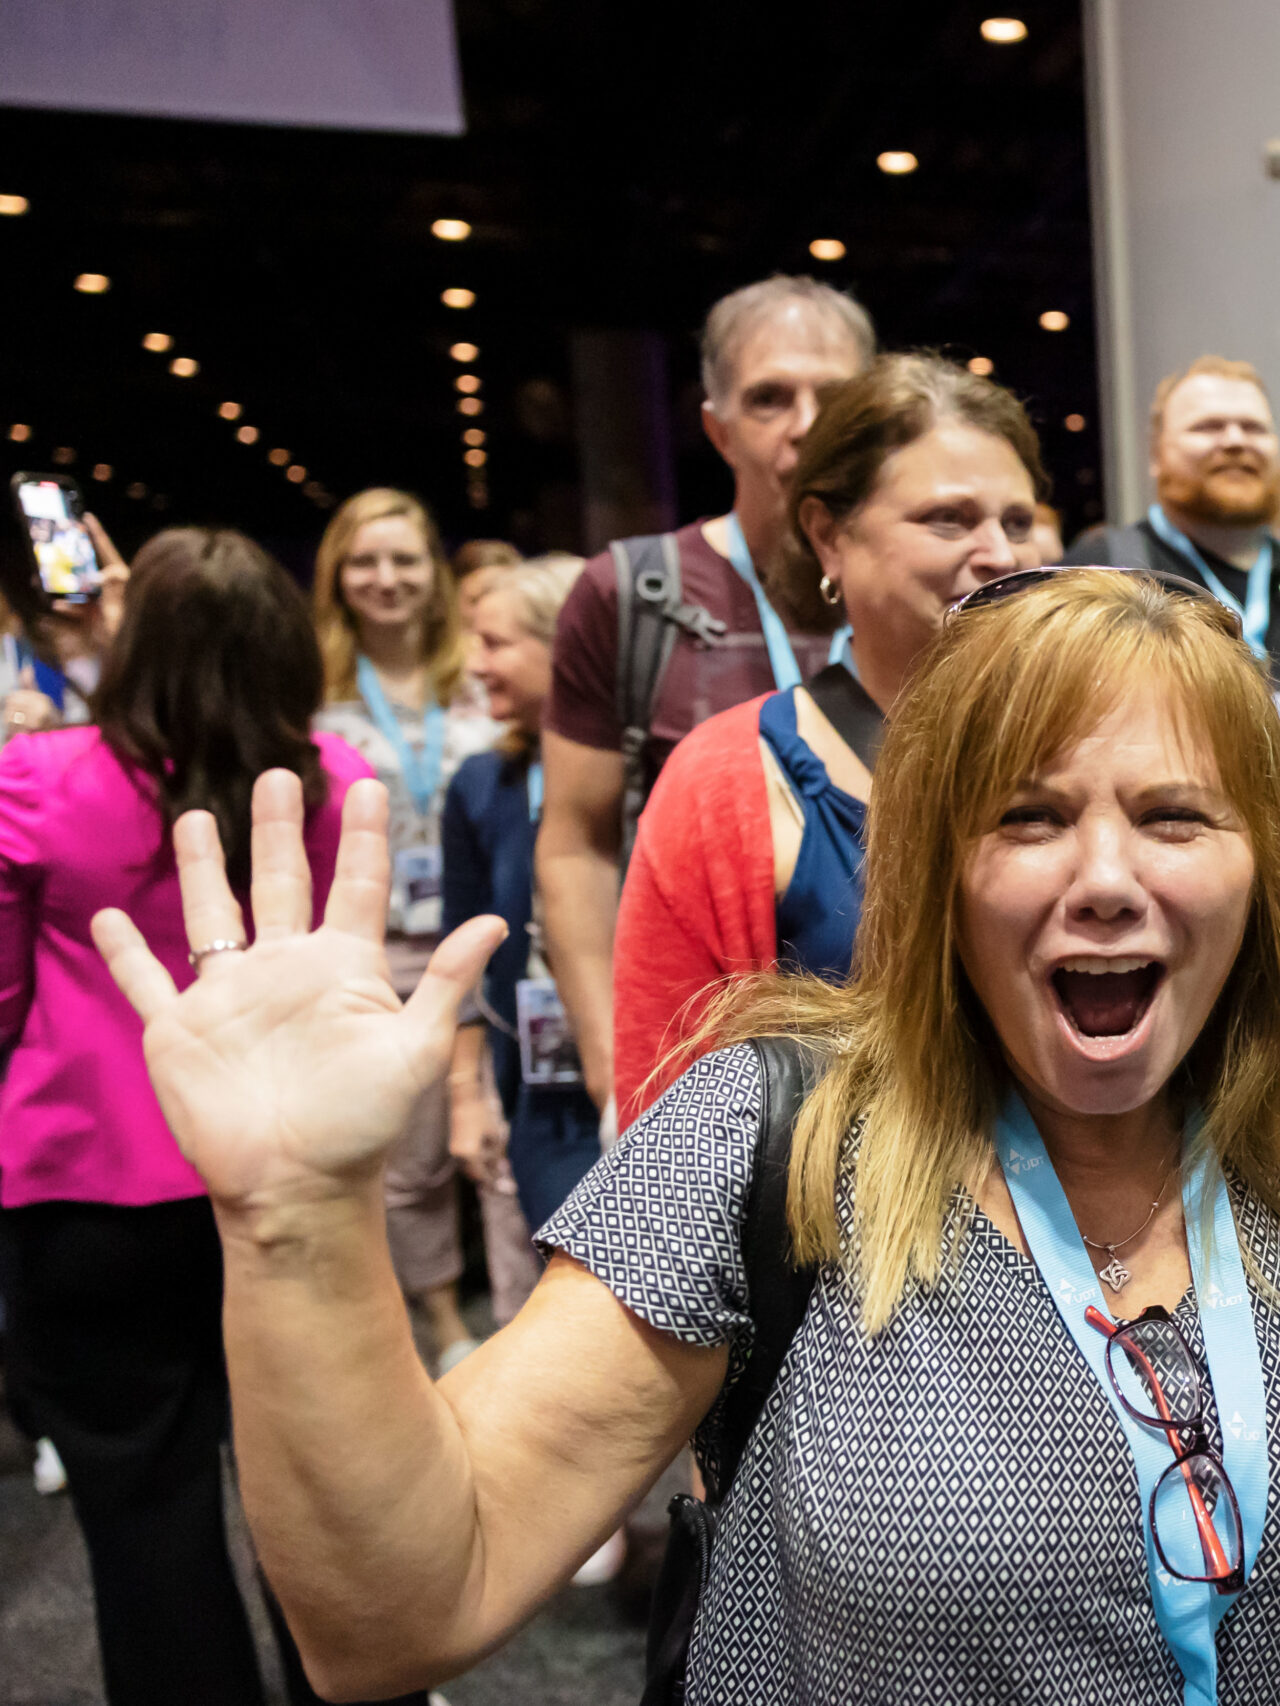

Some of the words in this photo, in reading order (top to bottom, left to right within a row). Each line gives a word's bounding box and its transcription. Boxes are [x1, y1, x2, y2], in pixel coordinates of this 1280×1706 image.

[1022, 1155, 1044, 1171] UDT
[1072, 1287, 1097, 1304] UDT
[1219, 1293, 1243, 1308] UDT
